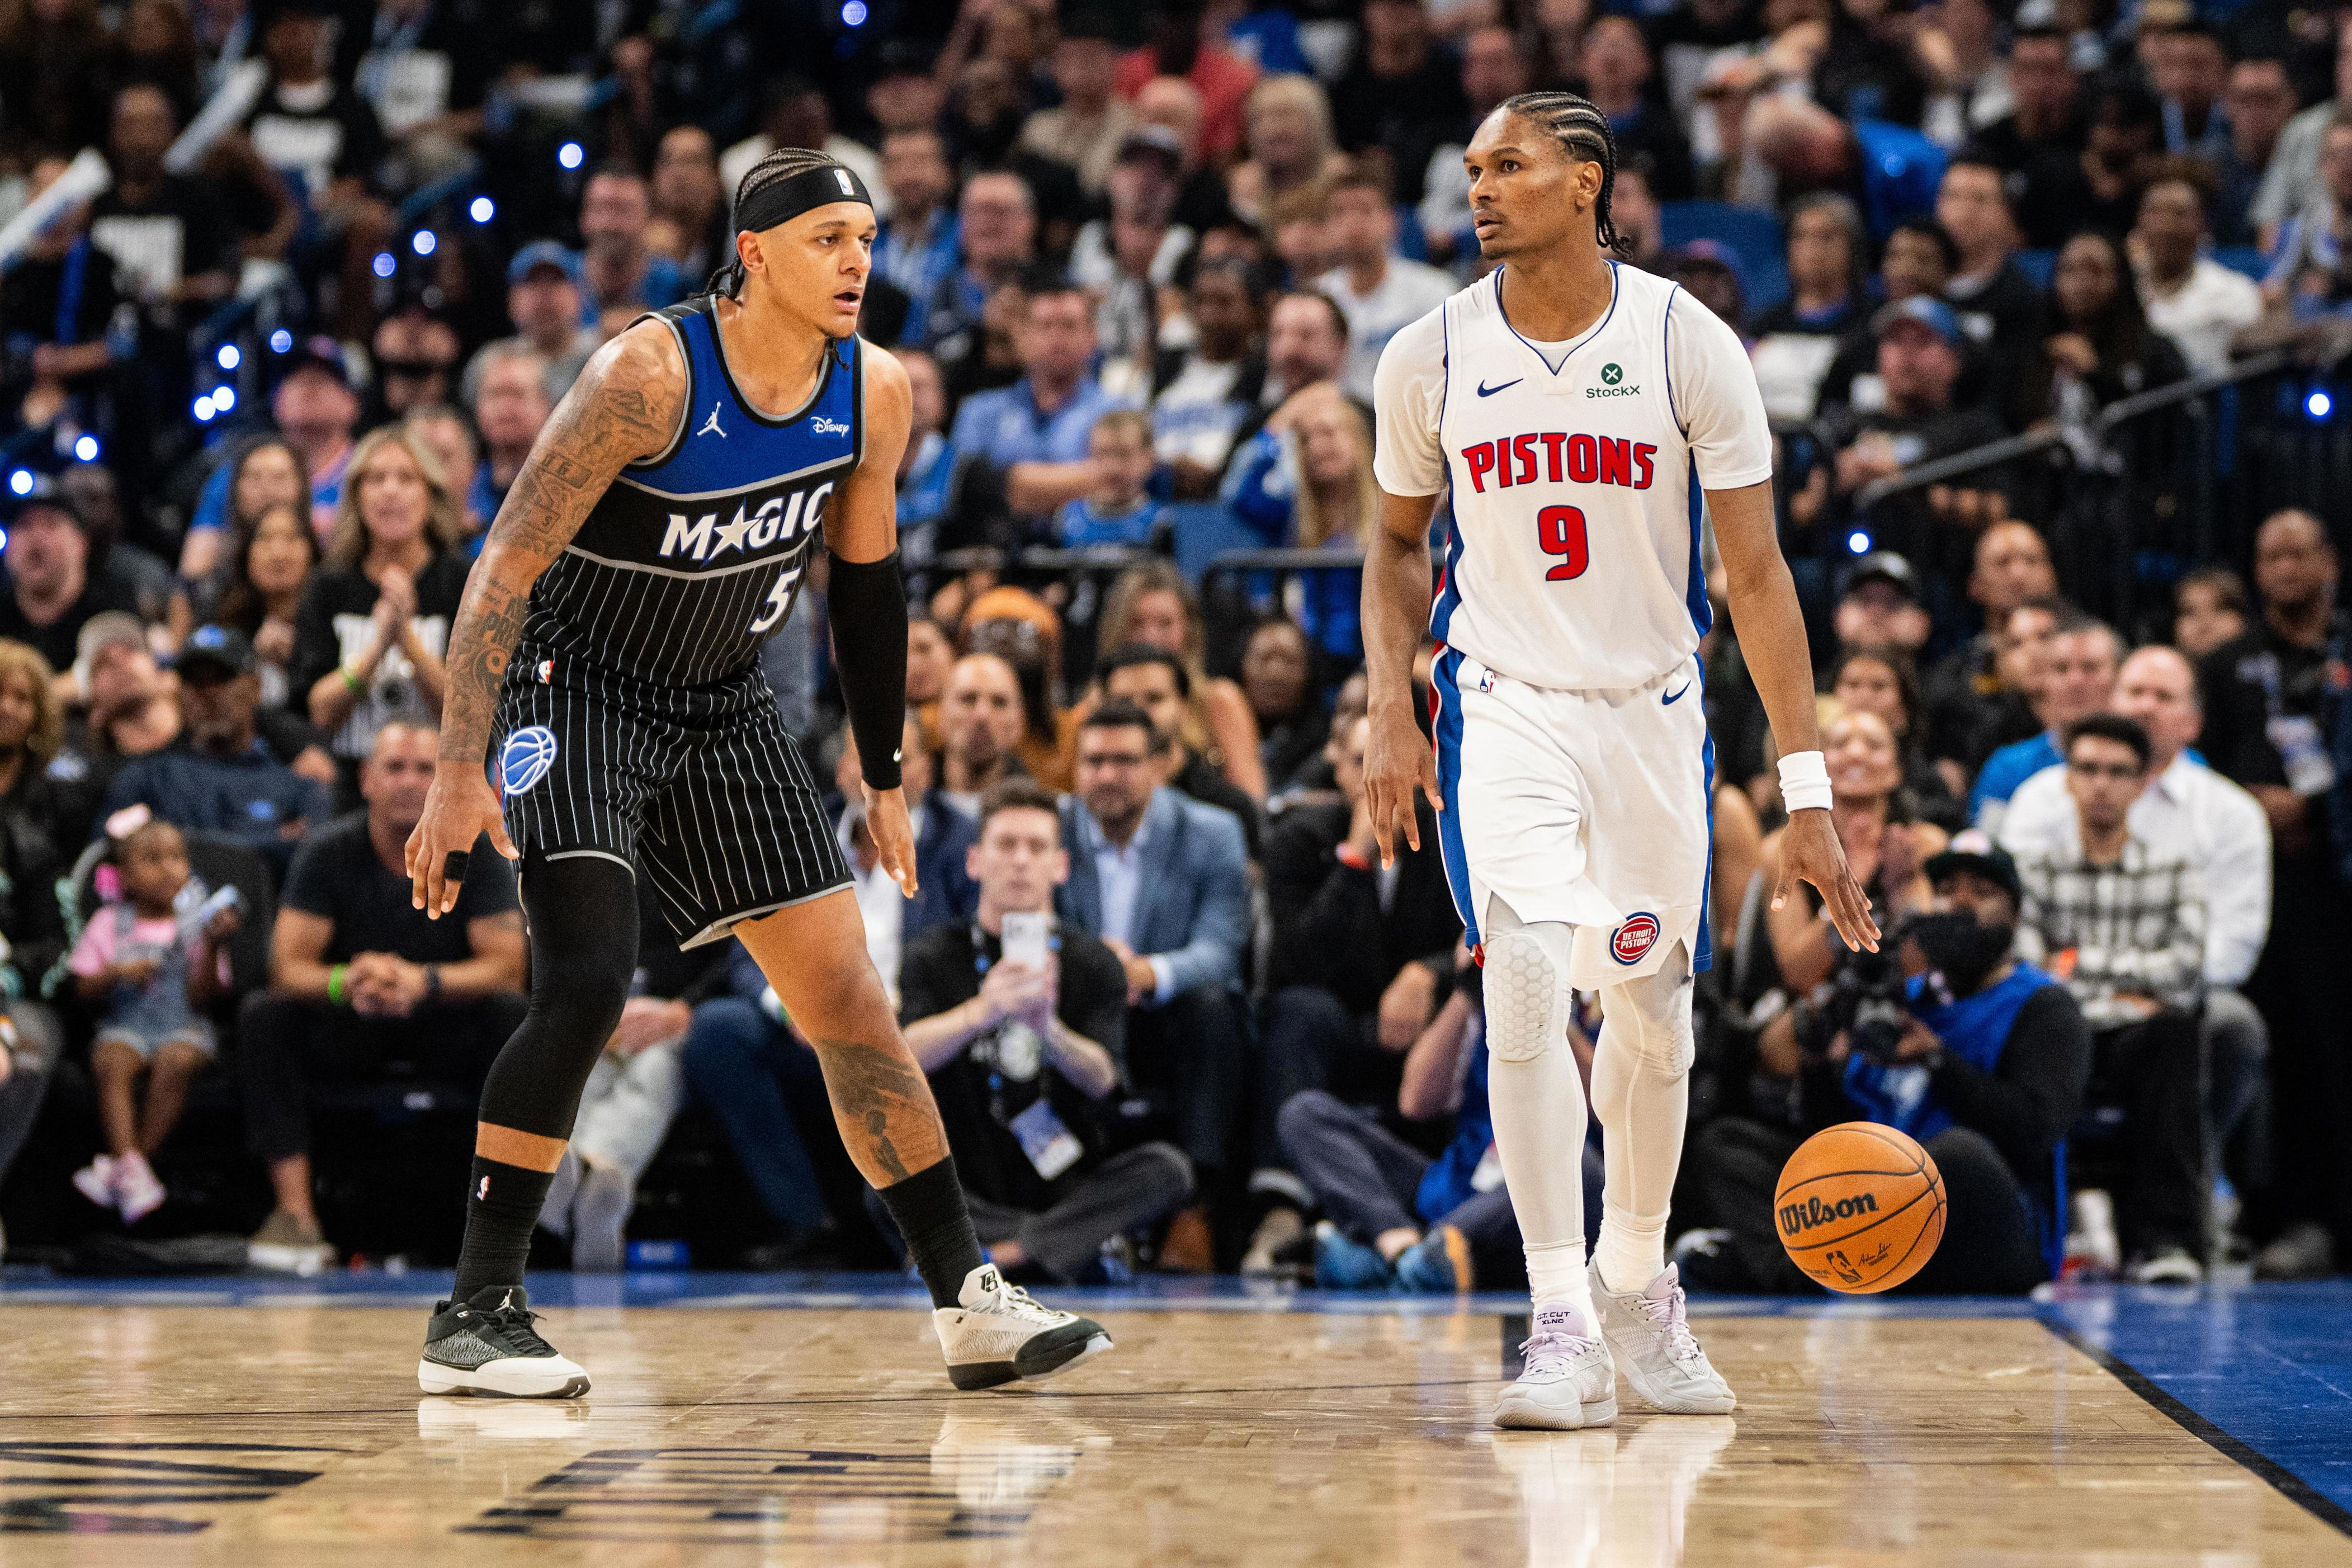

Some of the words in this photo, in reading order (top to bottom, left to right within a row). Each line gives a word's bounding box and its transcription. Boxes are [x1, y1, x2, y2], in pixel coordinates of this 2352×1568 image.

[1586, 385, 1640, 398] StockX
[810, 416, 849, 437] Disney
[1461, 432, 1657, 493] PISTONS
[1537, 504, 1589, 582] 9
[747, 566, 802, 633] 5
[1619, 936, 1651, 950] PISTONS
[1622, 928, 1652, 941] DETROIT
[1779, 1193, 1879, 1236] Wilson
